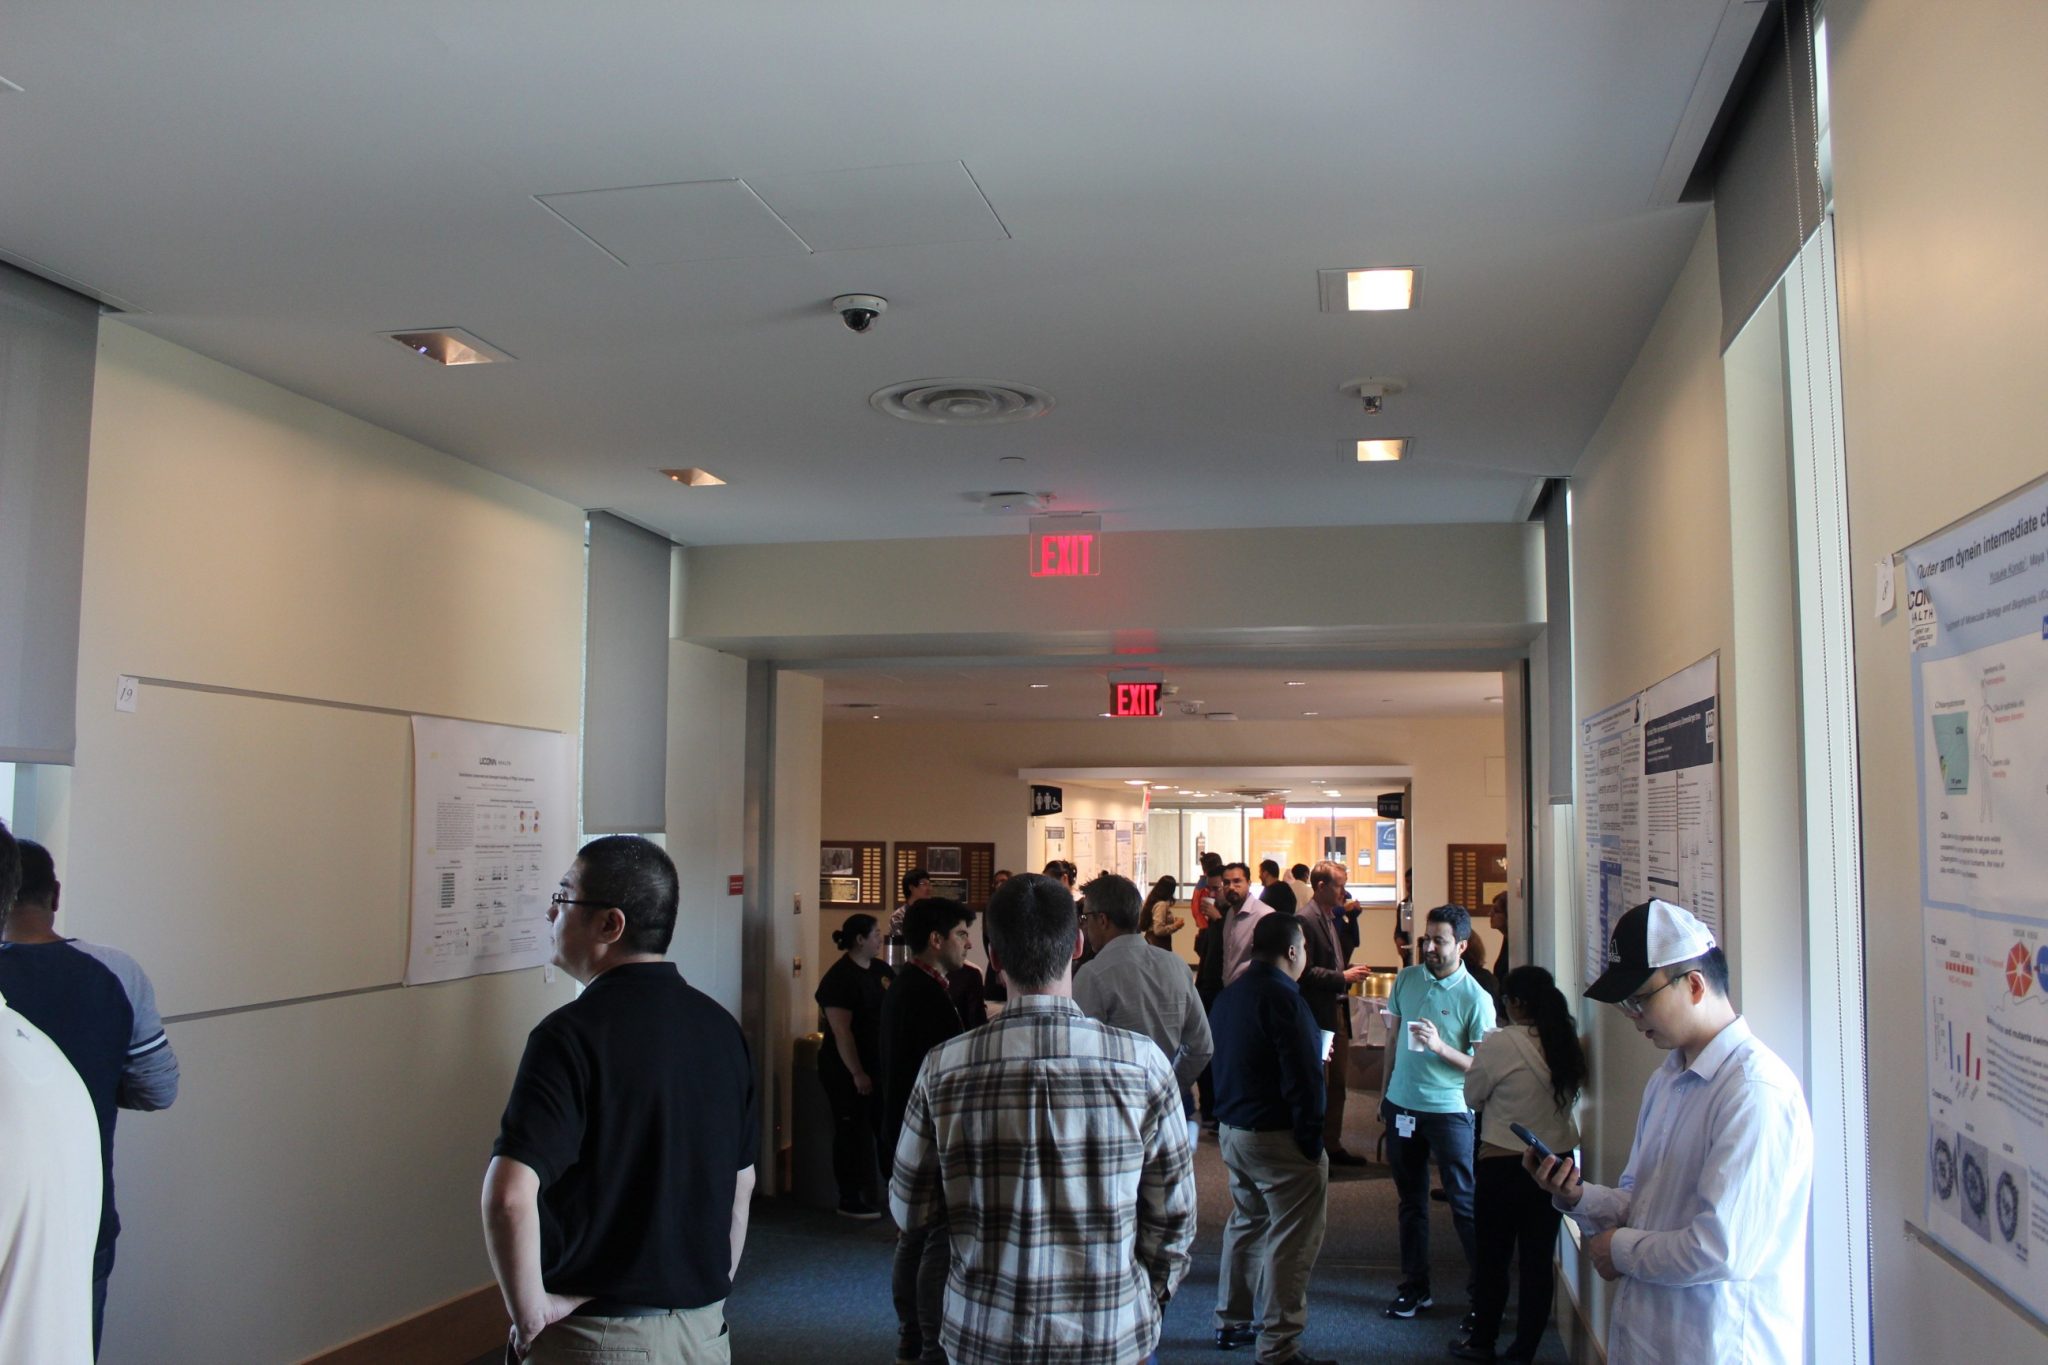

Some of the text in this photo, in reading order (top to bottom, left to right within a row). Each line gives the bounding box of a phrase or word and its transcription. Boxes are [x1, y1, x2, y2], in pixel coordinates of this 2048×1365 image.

[1041, 535, 1093, 575] EXIT
[1917, 562, 1939, 580] Outer
[1940, 555, 1955, 573] arm
[1956, 541, 1981, 569] dynein
[1983, 515, 2038, 555] intermediate
[120, 687, 133, 702] 19
[1117, 684, 1157, 715] EXIT
